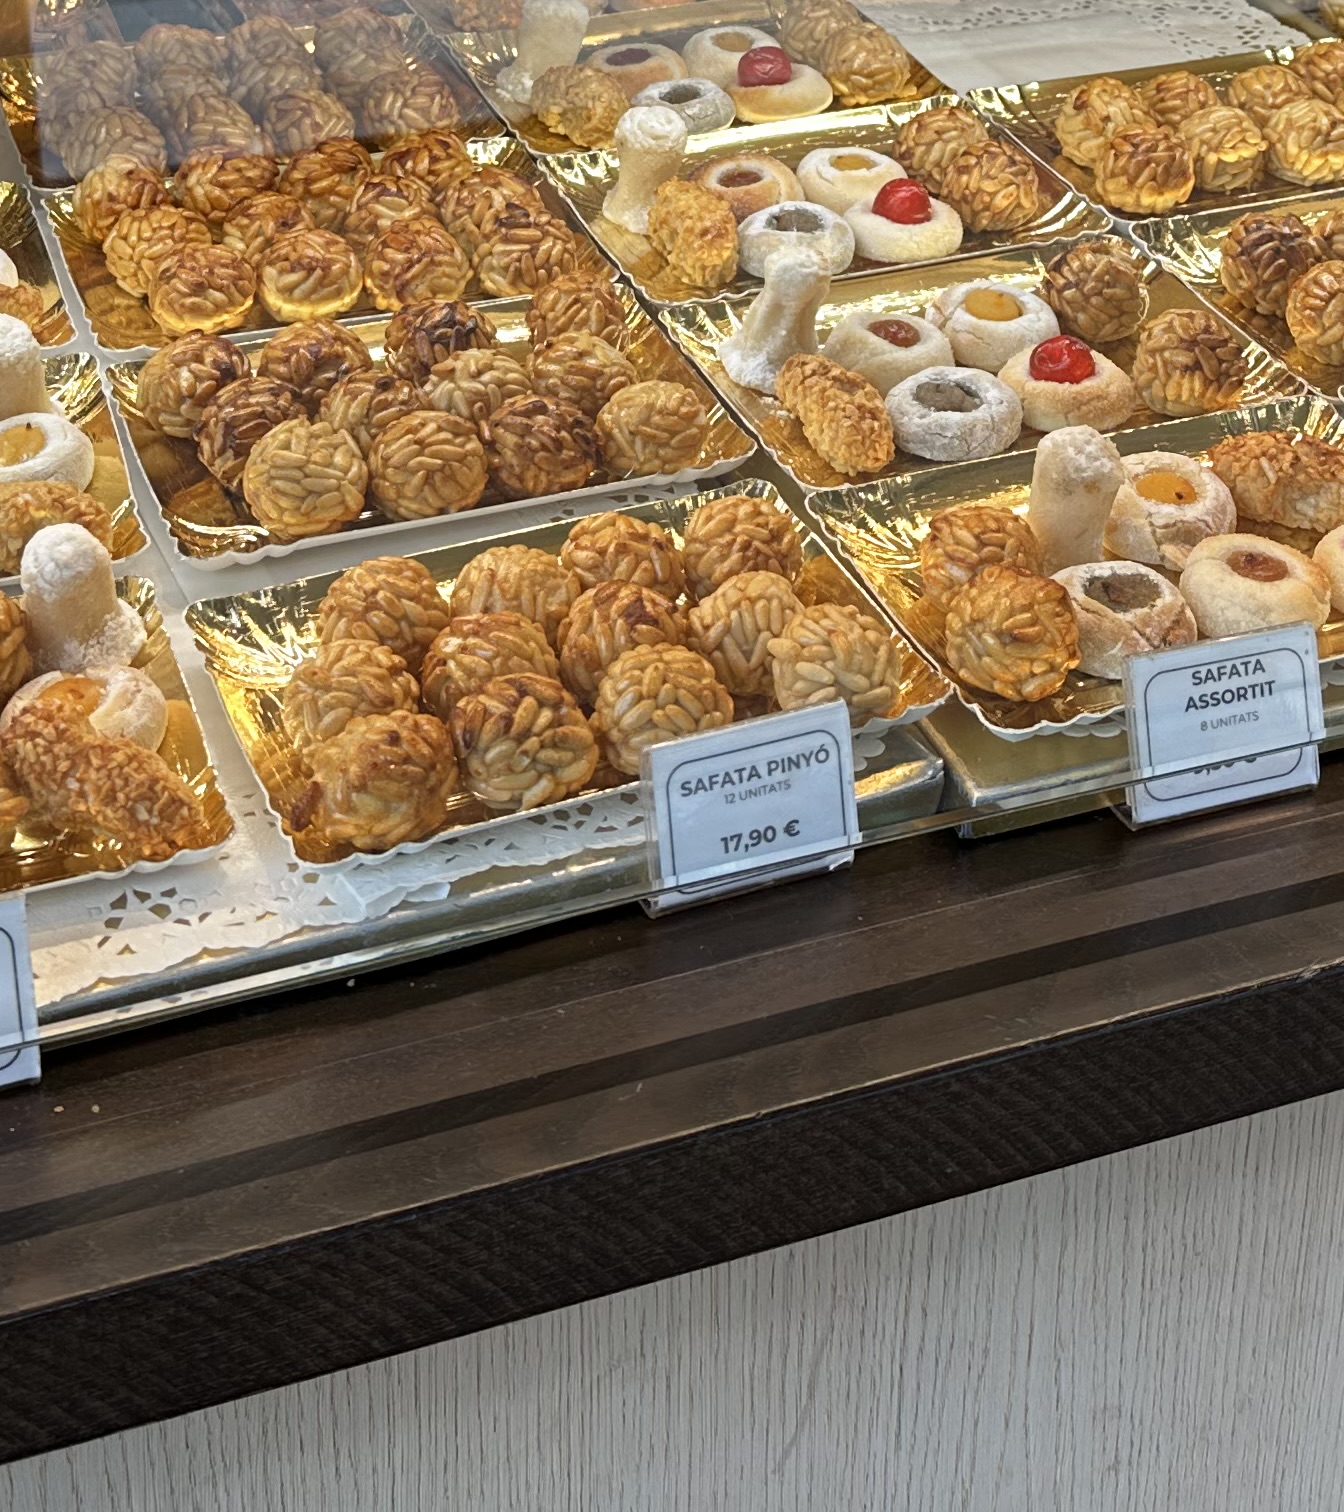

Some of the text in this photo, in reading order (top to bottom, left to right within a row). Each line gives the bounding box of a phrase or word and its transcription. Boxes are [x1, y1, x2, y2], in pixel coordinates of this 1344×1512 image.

[1191, 658, 1266, 686] SAFATA
[1184, 680, 1276, 713] ASSORTIT
[1200, 711, 1260, 732] 8 UNITATS
[680, 743, 830, 798] SAFATA PINYÓ
[724, 779, 792, 805] 12 UNITATS
[720, 819, 801, 854] 17,90 €
